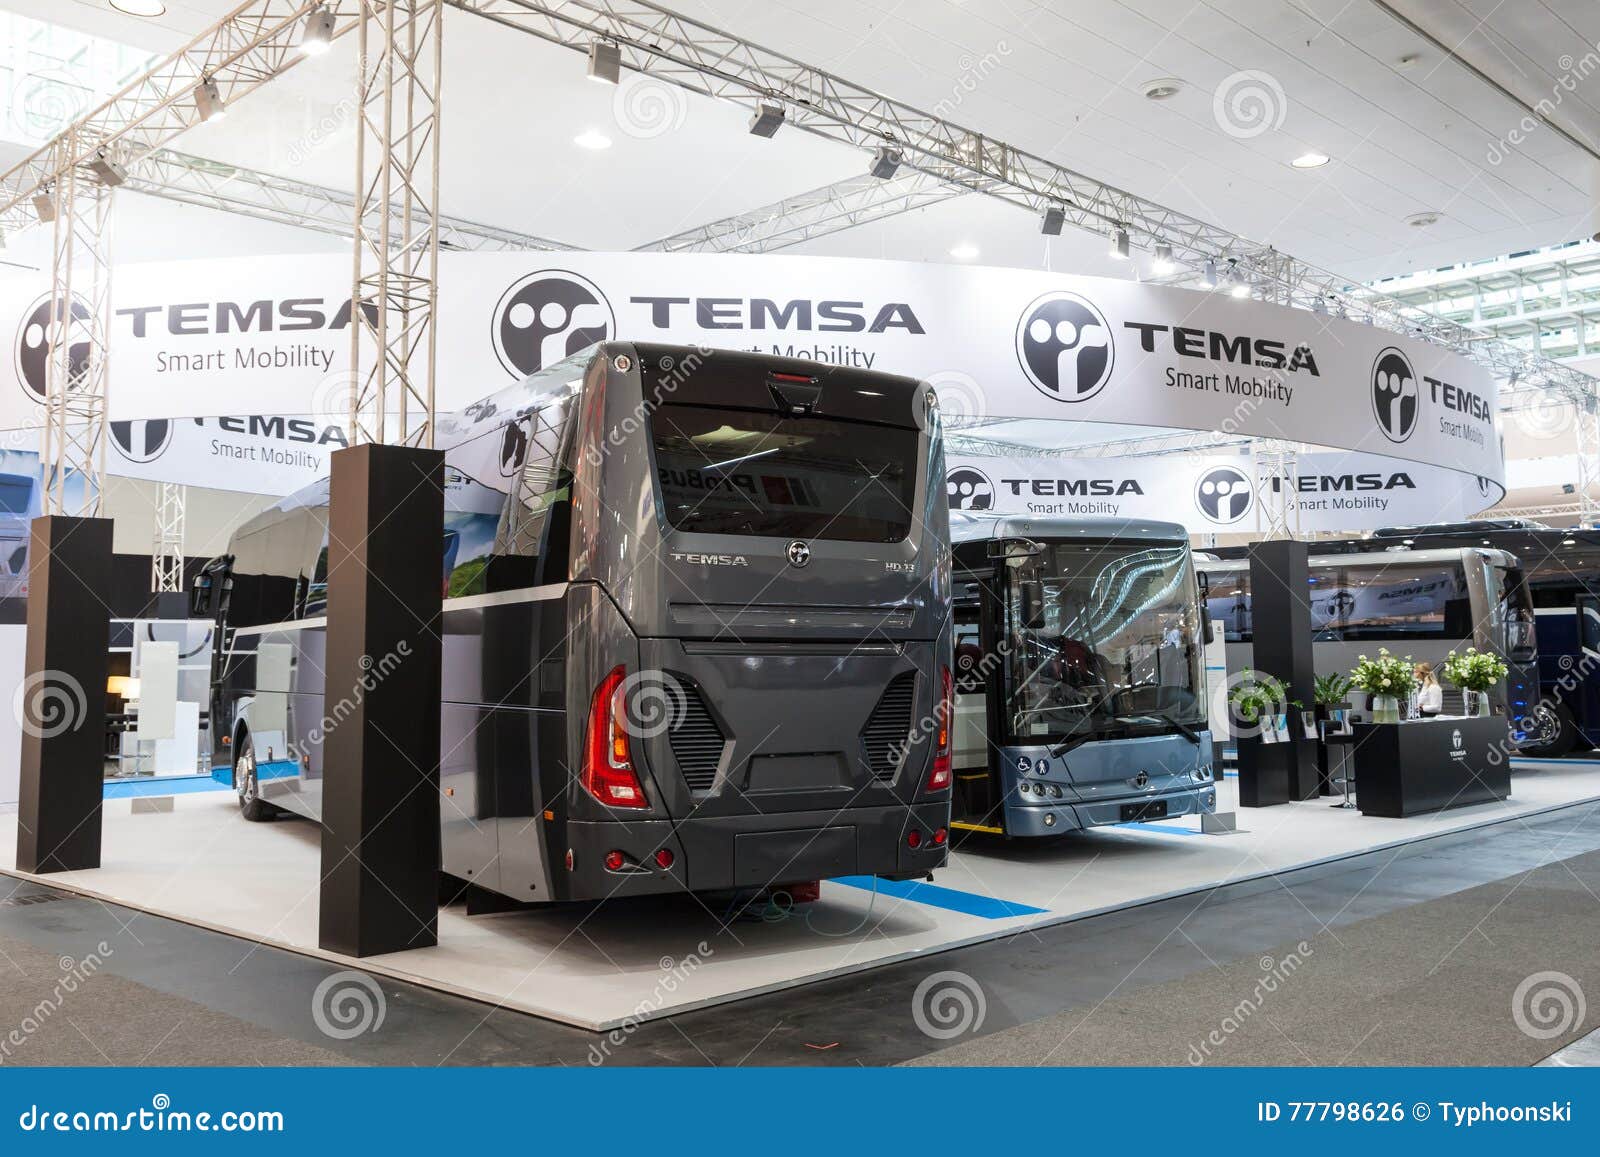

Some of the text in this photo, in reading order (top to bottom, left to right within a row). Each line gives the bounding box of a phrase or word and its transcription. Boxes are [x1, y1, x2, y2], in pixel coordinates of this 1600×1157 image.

[116, 298, 388, 338] TEMSA
[630, 296, 926, 335] TEMSA
[156, 344, 335, 373] Smart Mobility
[1124, 321, 1321, 377] TEMSA
[1165, 367, 1293, 407] Smart Mobility
[1423, 375, 1491, 425] TEMSA
[1440, 416, 1462, 438] Smart
[211, 439, 321, 472] Smart Mobility
[1001, 479, 1145, 496] TEMSA
[1027, 502, 1120, 516] Smart Mobility
[1333, 496, 1389, 511] Mobility
[669, 552, 749, 567] TEMSA
[885, 561, 902, 572] HD
